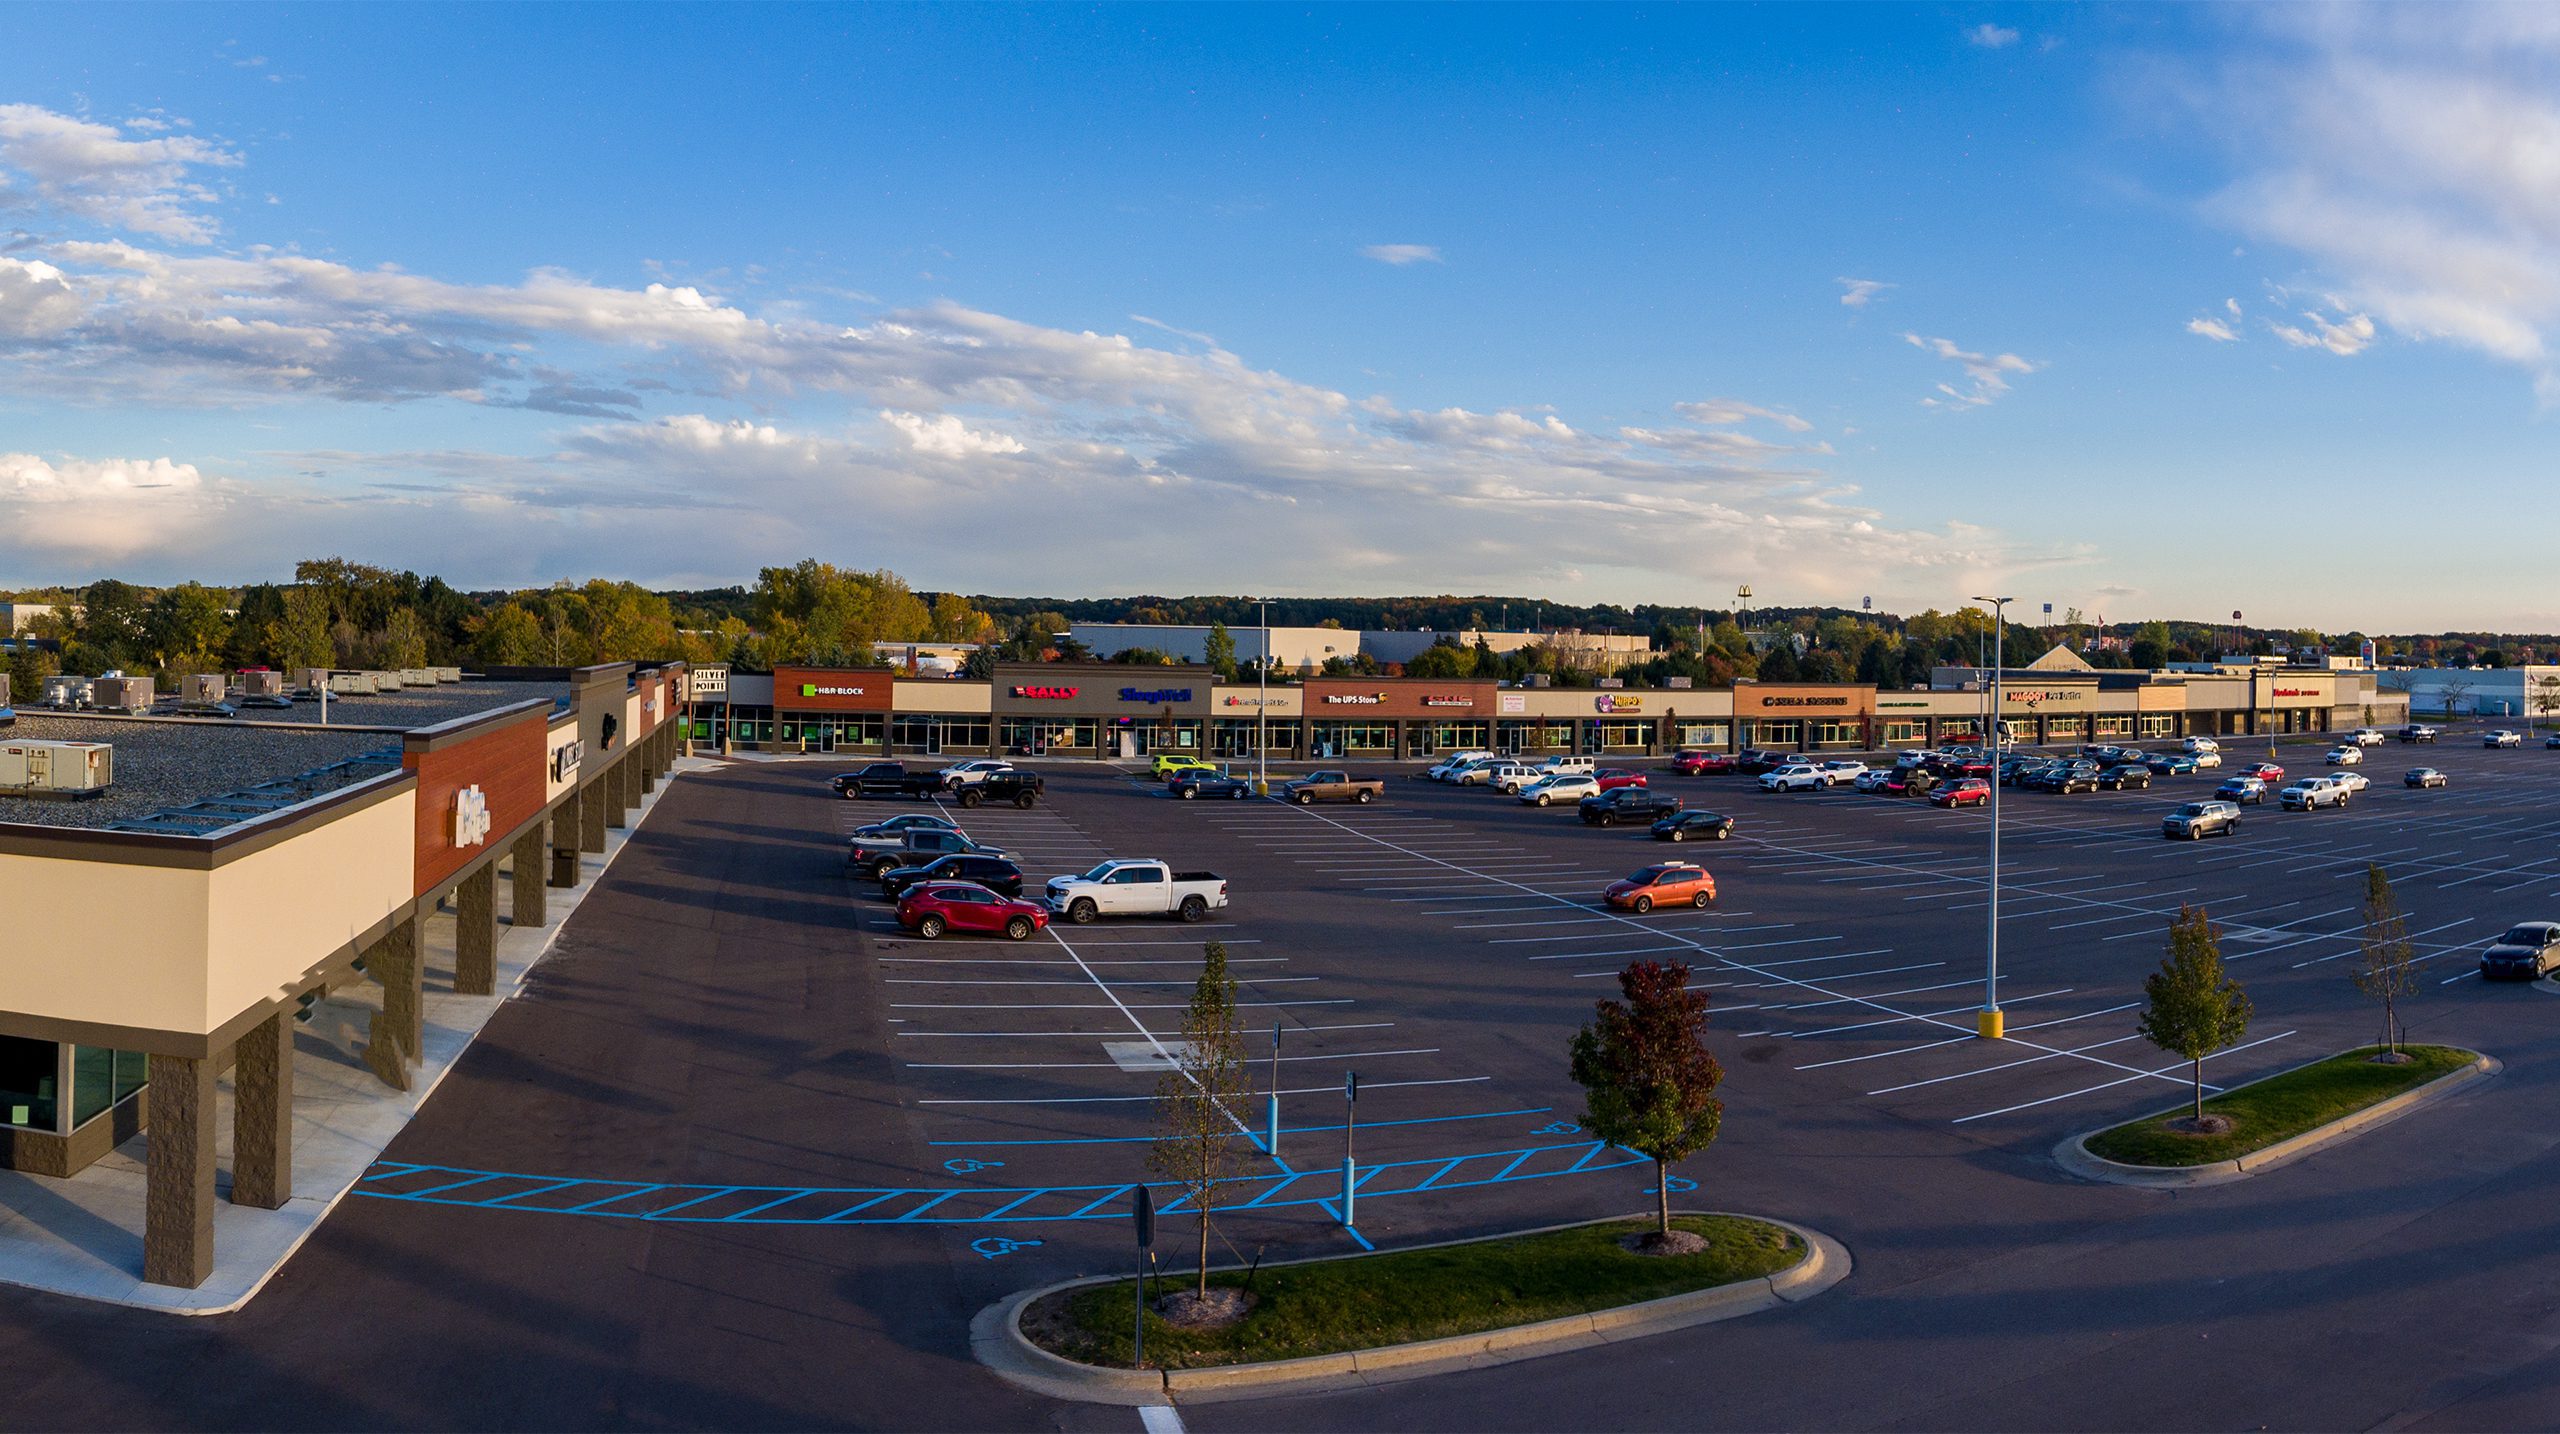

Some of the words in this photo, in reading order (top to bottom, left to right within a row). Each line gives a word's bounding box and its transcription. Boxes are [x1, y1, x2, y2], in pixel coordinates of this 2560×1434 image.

[696, 671, 725, 679] SILVER
[696, 682, 724, 690] POINTE
[837, 687, 864, 695] BLOCK
[1025, 686, 1080, 699] SALLY
[1328, 695, 1342, 704] The
[1342, 695, 1357, 704] UPS
[1358, 695, 1377, 704] Store
